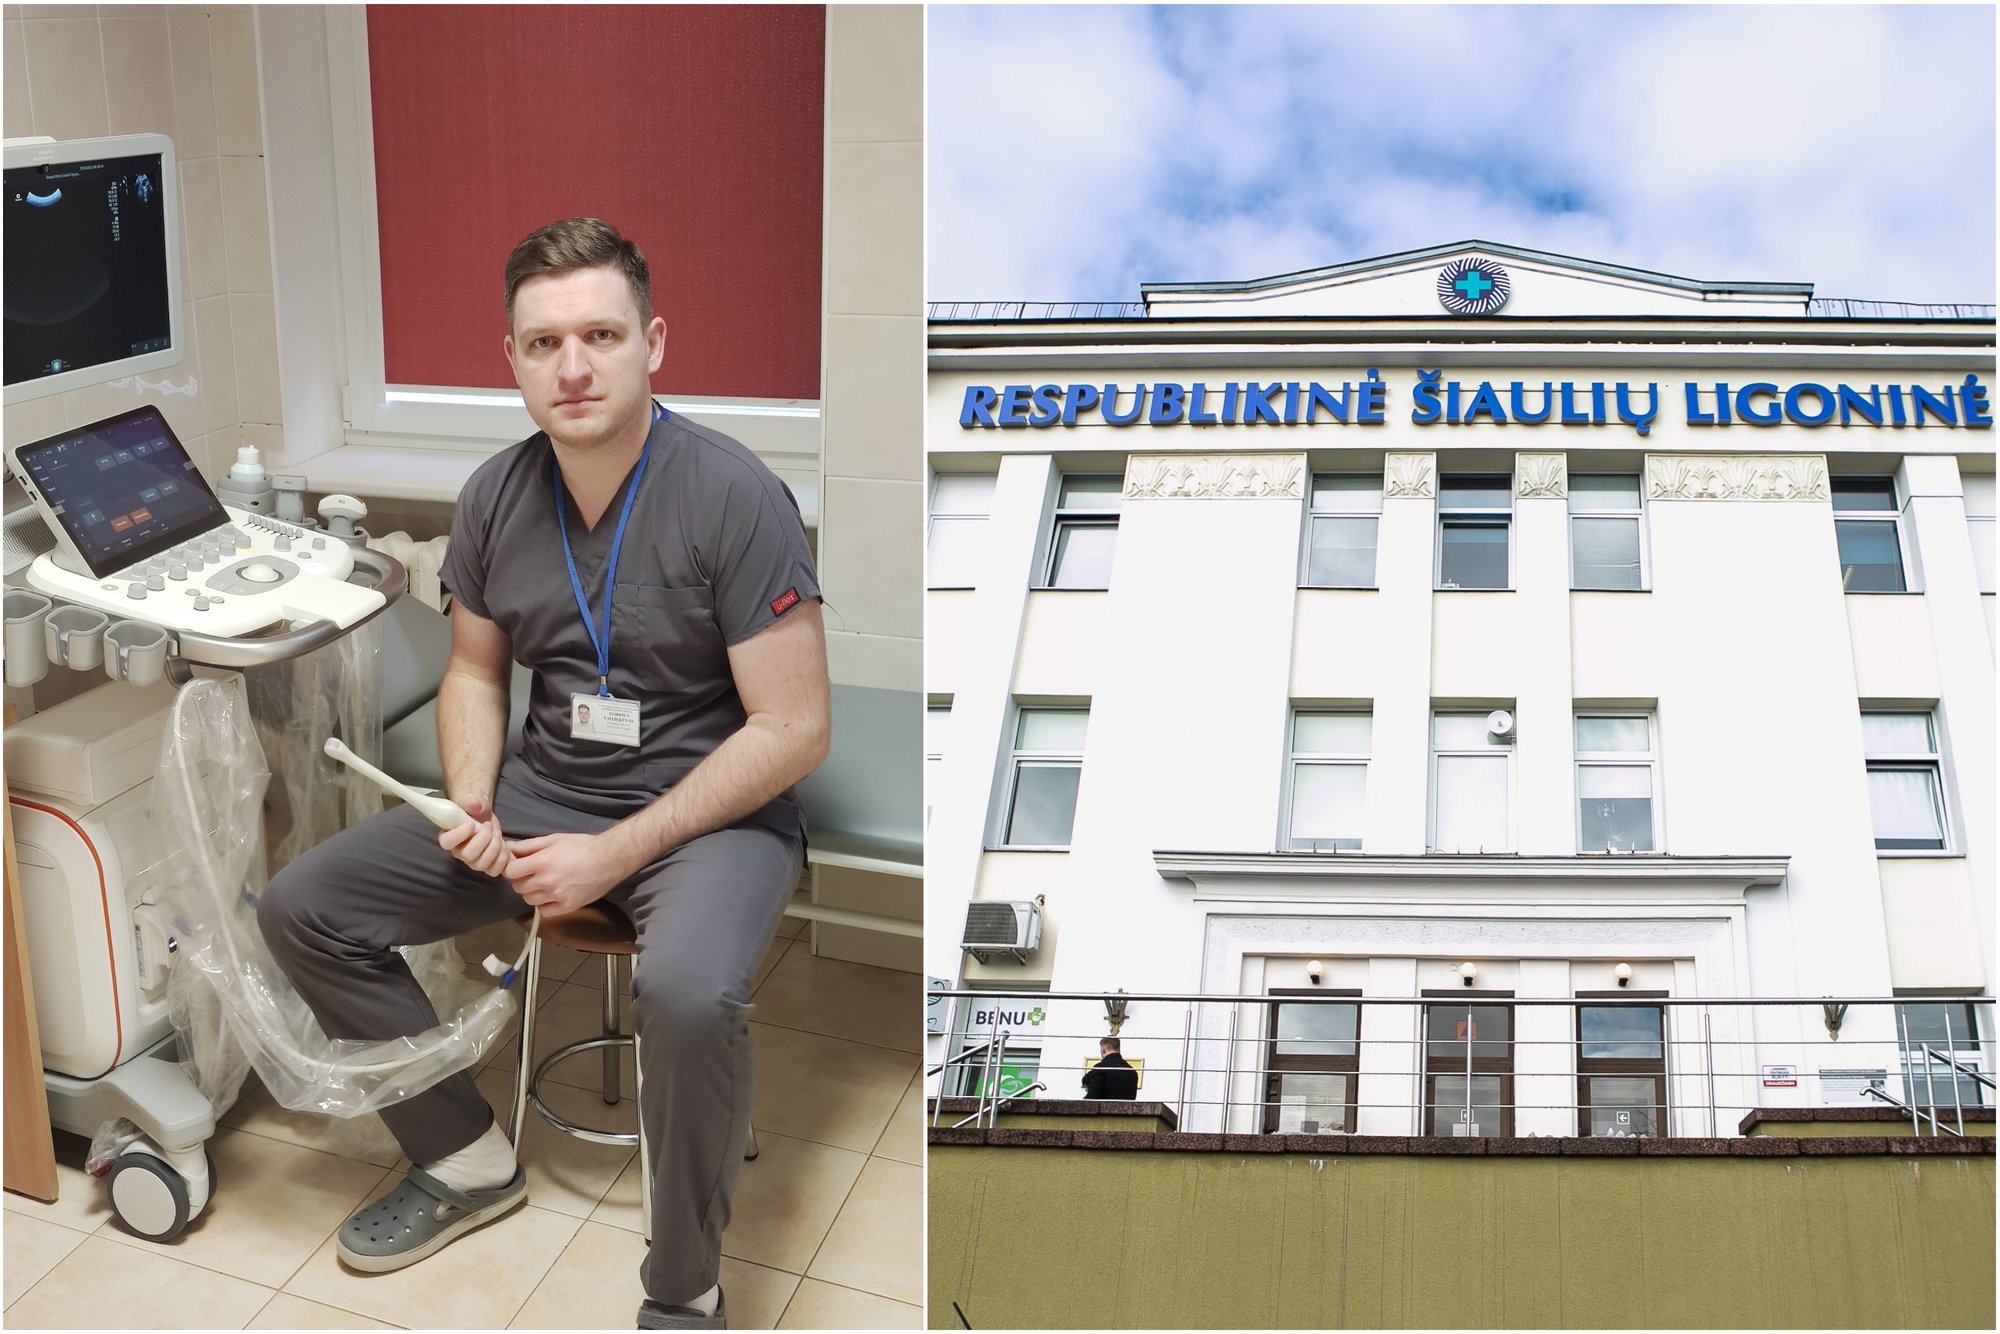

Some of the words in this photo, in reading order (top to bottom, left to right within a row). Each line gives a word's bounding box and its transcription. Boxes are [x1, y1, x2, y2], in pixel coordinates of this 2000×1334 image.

[958, 367, 1387, 428] RESPUBLIKINĖ
[1411, 368, 1659, 435] ŠIAULIŲ
[1684, 373, 1994, 429] LIGONINĖ
[975, 1011, 1026, 1025] BENU
